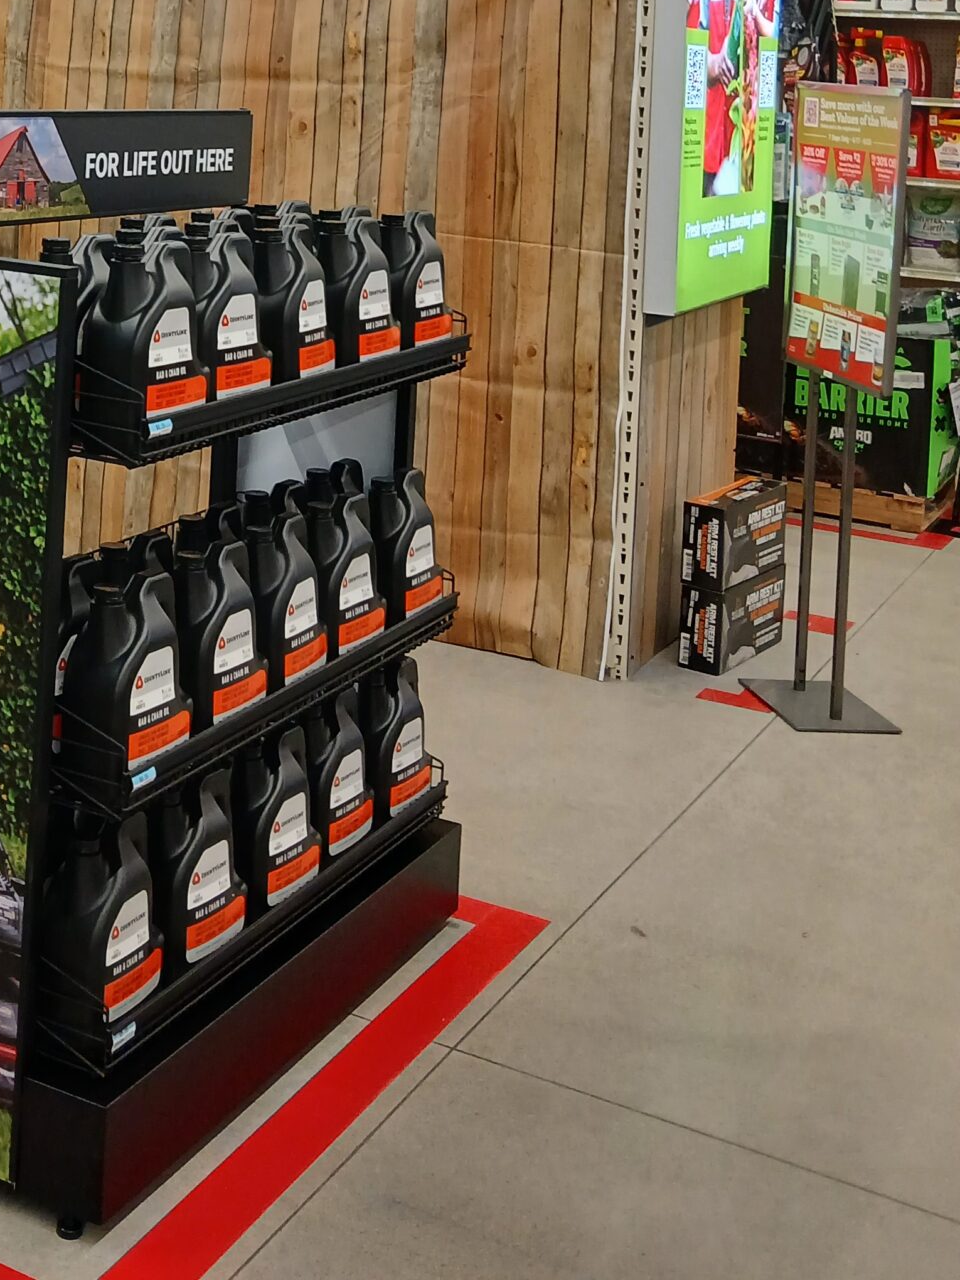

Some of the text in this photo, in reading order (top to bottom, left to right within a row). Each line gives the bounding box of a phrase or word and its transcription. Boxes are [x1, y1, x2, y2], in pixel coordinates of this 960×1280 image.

[85, 148, 234, 179] FOR LIFE OUT HERE
